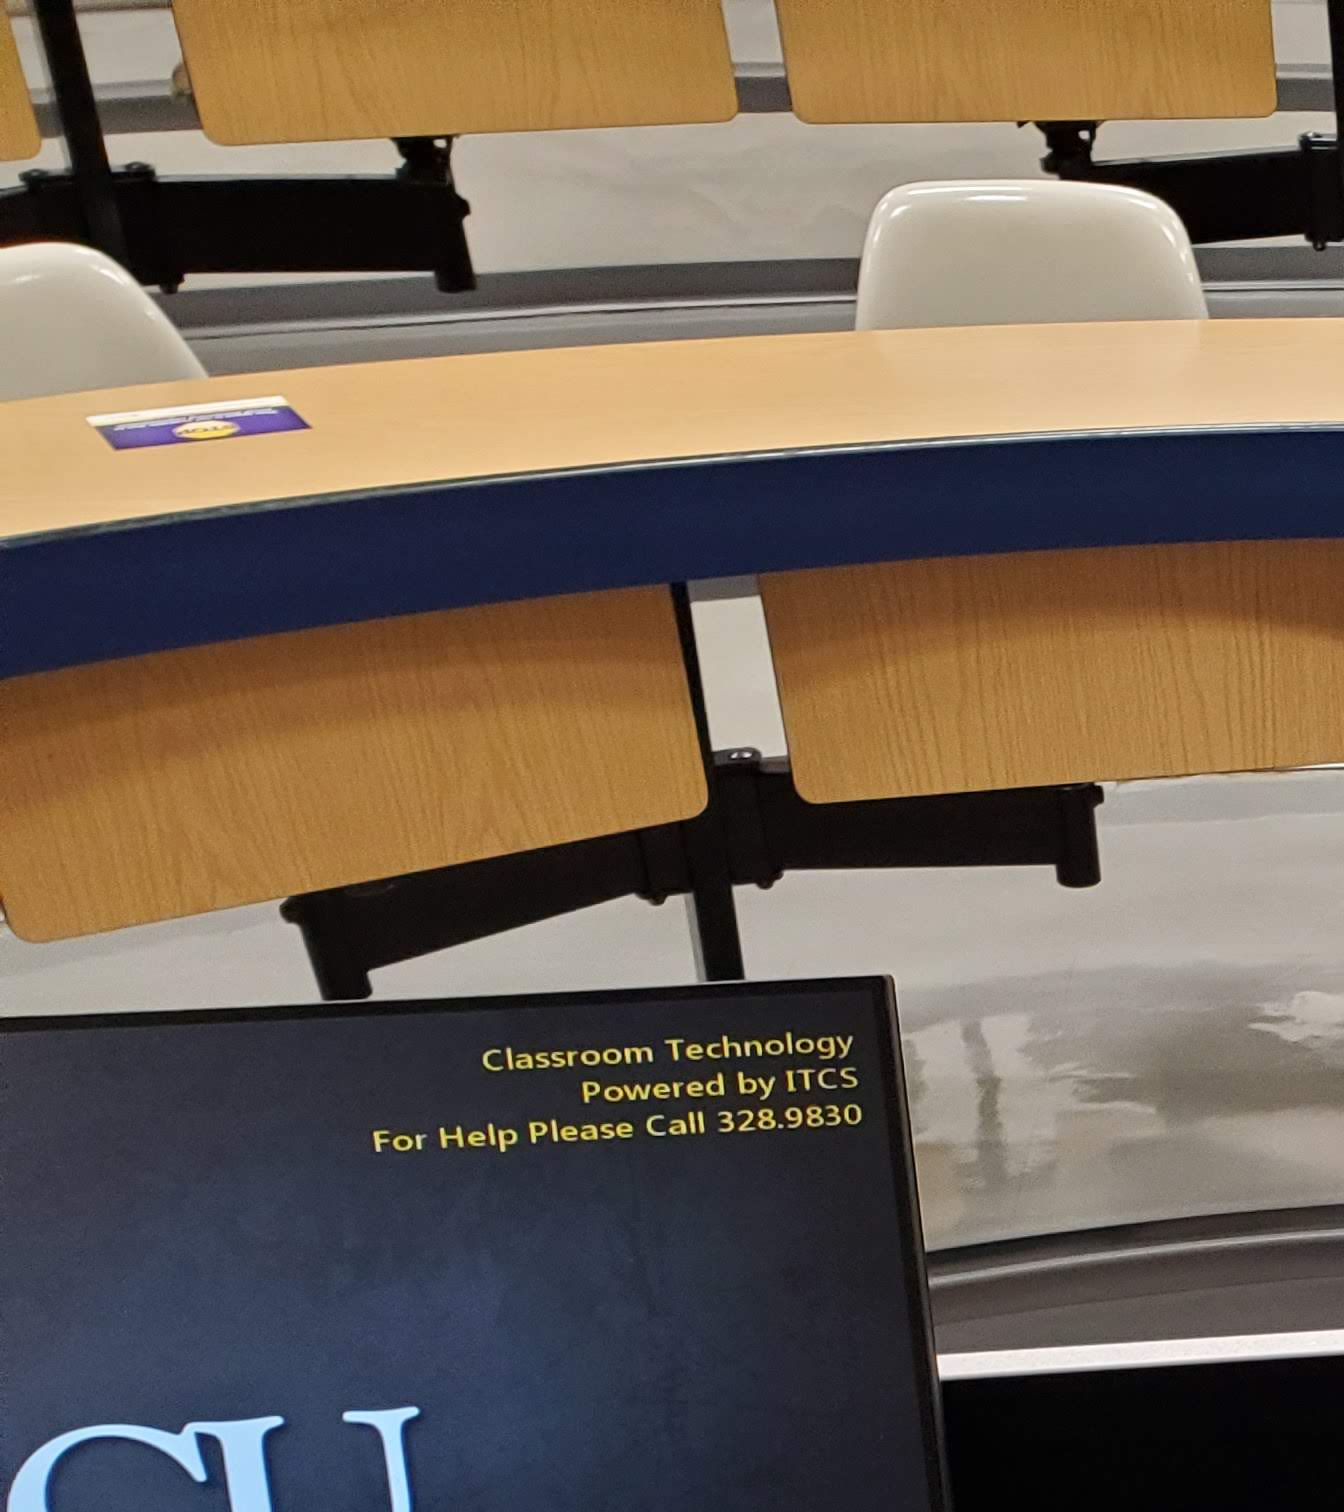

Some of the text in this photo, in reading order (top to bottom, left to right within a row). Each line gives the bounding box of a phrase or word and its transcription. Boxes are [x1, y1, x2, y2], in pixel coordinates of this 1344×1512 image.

[482, 1032, 853, 1071] Classroom Technology
[582, 1067, 858, 1103] Powered by ITCS
[372, 1103, 862, 1152] For Help Please Call 328.9830
